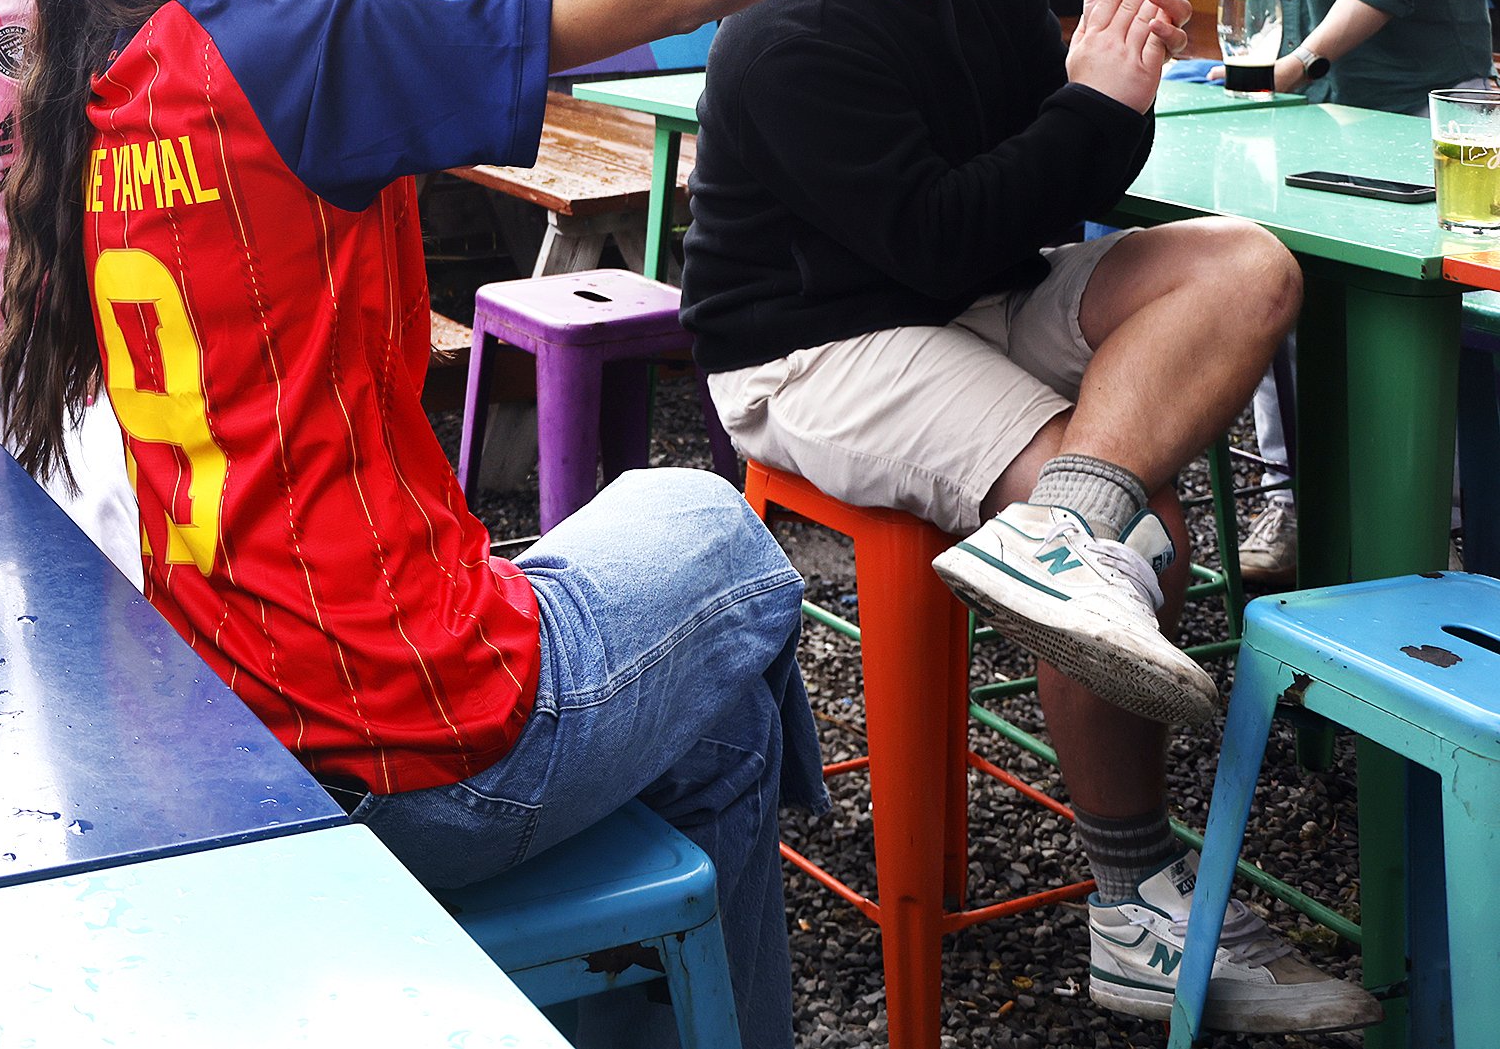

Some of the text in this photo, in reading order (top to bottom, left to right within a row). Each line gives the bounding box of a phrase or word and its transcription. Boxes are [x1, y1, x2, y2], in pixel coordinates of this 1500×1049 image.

[112, 136, 220, 212] YAMAL
[95, 248, 227, 576] 9
[1036, 546, 1083, 576] N
[1147, 942, 1183, 976] N
